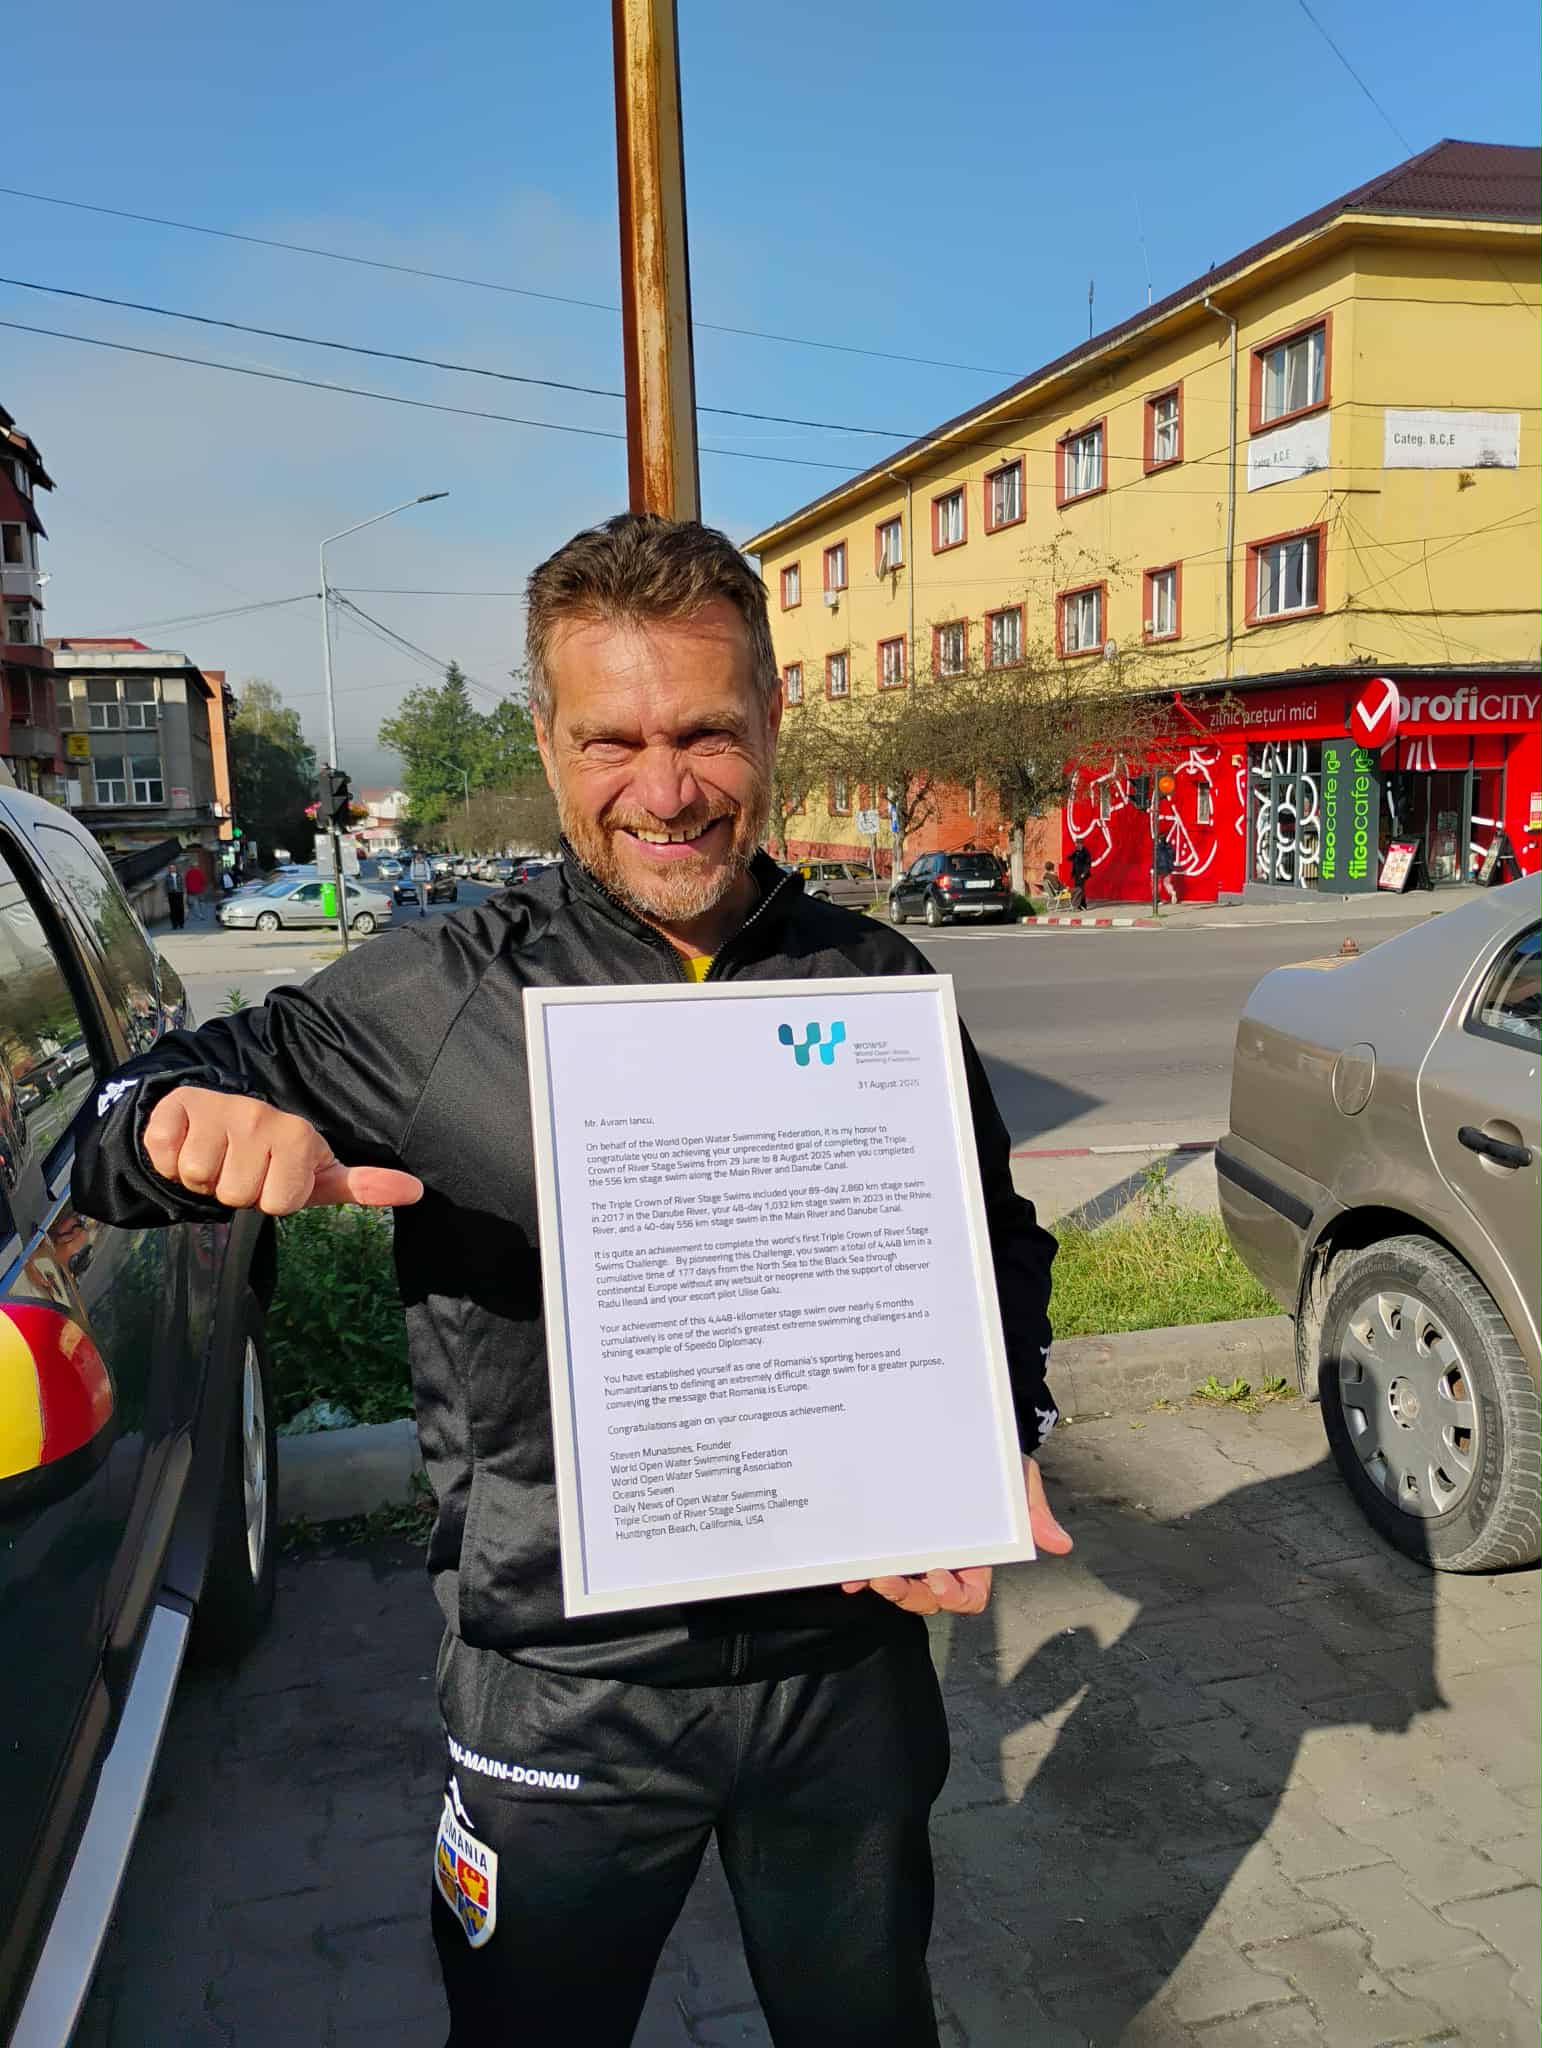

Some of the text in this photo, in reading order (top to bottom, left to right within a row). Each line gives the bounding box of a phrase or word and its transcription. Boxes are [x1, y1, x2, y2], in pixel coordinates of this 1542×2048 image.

[1393, 432, 1426, 447] Categ.
[1289, 700, 1317, 721] mici
[600, 1119, 628, 1127] Avram
[586, 1143, 599, 1151] On
[600, 1140, 627, 1150] behalf
[628, 1140, 638, 1148] of
[639, 1139, 654, 1148] the
[654, 1137, 681, 1147] World
[681, 1137, 704, 1147] Open
[705, 1135, 731, 1143] Water
[732, 1132, 776, 1142] Swimming
[853, 1126, 878, 1134] honor
[587, 1153, 641, 1164] congratulate
[642, 1153, 659, 1162] you
[672, 1148, 712, 1158] achieving
[712, 1148, 732, 1157] your
[733, 1142, 795, 1155] unprecedented
[795, 1141, 814, 1152] goal
[814, 1140, 824, 1148] of
[824, 1138, 870, 1149] completing
[870, 1136, 884, 1145] the
[884, 1135, 907, 1145] Triple
[587, 1167, 616, 1175] Crown
[617, 1164, 627, 1173] of
[627, 1164, 650, 1172] River
[651, 1163, 676, 1172] Stage
[677, 1160, 706, 1169] Swims
[706, 1159, 728, 1167] from
[741, 1157, 761, 1165] June
[779, 1153, 809, 1164] August
[833, 1150, 857, 1159] when
[857, 1150, 873, 1159] you
[588, 1178, 604, 1187] the
[623, 1176, 638, 1184] km
[639, 1175, 663, 1185] stage
[664, 1173, 687, 1182] swim
[688, 1172, 712, 1181] along
[712, 1170, 728, 1178] the
[728, 1169, 750, 1177] Main
[750, 1167, 772, 1176] River
[773, 1165, 789, 1174] and
[790, 1163, 822, 1173] Danube
[592, 1202, 609, 1211] The
[610, 1200, 634, 1211] Triple
[634, 1199, 663, 1208] Crown
[664, 1197, 674, 1206] of
[674, 1196, 697, 1205] River
[697, 1195, 723, 1204] Stage
[723, 1192, 752, 1201] Swims
[752, 1189, 788, 1199] included
[789, 1189, 808, 1199] your
[591, 1215, 600, 1223] in
[601, 1213, 625, 1222] 2017
[636, 1211, 651, 1220] the
[652, 1208, 686, 1218] Danube
[711, 1207, 731, 1216] your
[715, 1226, 929, 1250] complete first Triple Crown Stage
[796, 1248, 812, 1257] you
[846, 1241, 867, 1251] total
[645, 1271, 666, 1280] time
[696, 1267, 717, 1277] days
[717, 1265, 739, 1274] from
[755, 1260, 781, 1271] North
[824, 1255, 848, 1265] Black
[865, 1251, 898, 1262] through
[679, 1279, 713, 1289] without
[815, 1268, 834, 1278] with
[850, 1265, 883, 1276] support
[893, 1262, 930, 1271] observer
[667, 1289, 736, 1305] your pilot
[600, 1298, 915, 1333] Your swim over months
[744, 1315, 862, 1335] greatest swimming
[601, 1348, 634, 1359] shining
[604, 1353, 855, 1384] You have yourself sporting
[773, 1363, 870, 1380] difficult for
[607, 1421, 678, 1435] Congratulations
[679, 1417, 703, 1429] again
[717, 1415, 738, 1426] your
[695, 1440, 732, 1452] Founder
[610, 1448, 788, 1474] World Open Water Swimming Federation
[742, 1460, 793, 1473] Association
[647, 1487, 675, 1497] Seven
[613, 1494, 730, 1514] Daily News Open Water
[615, 1498, 809, 1528] Triple Stage Challenge
[615, 1527, 668, 1540] Huntington
[745, 1514, 765, 1525] USA
